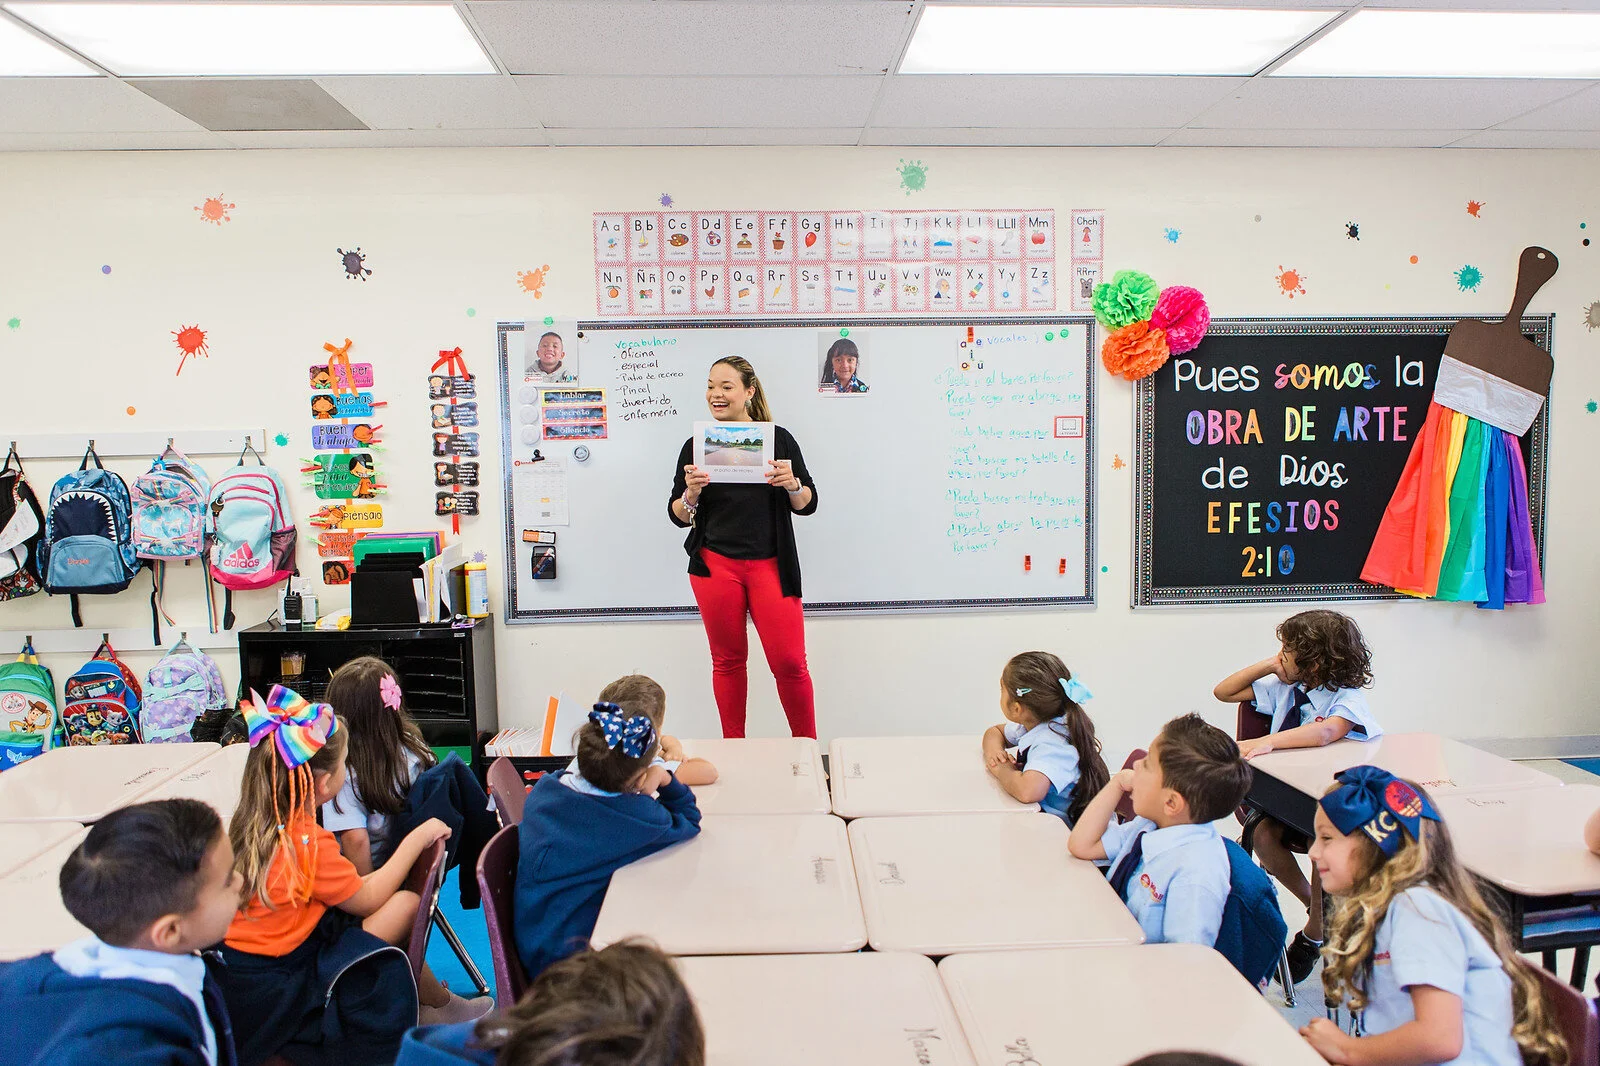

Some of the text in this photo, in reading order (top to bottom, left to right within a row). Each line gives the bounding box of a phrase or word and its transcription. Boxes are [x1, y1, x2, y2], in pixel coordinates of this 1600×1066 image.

[615, 336, 677, 349] vocabulario
[1174, 355, 1424, 392] Pues somos la
[1186, 406, 1407, 445] OBRA DE ARTE
[1201, 454, 1349, 489] de Dios
[1207, 499, 1340, 534] EFESIOS
[224, 558, 260, 569] adidas
[1241, 545, 1295, 578] 2:10
[1363, 810, 1398, 843] KC
